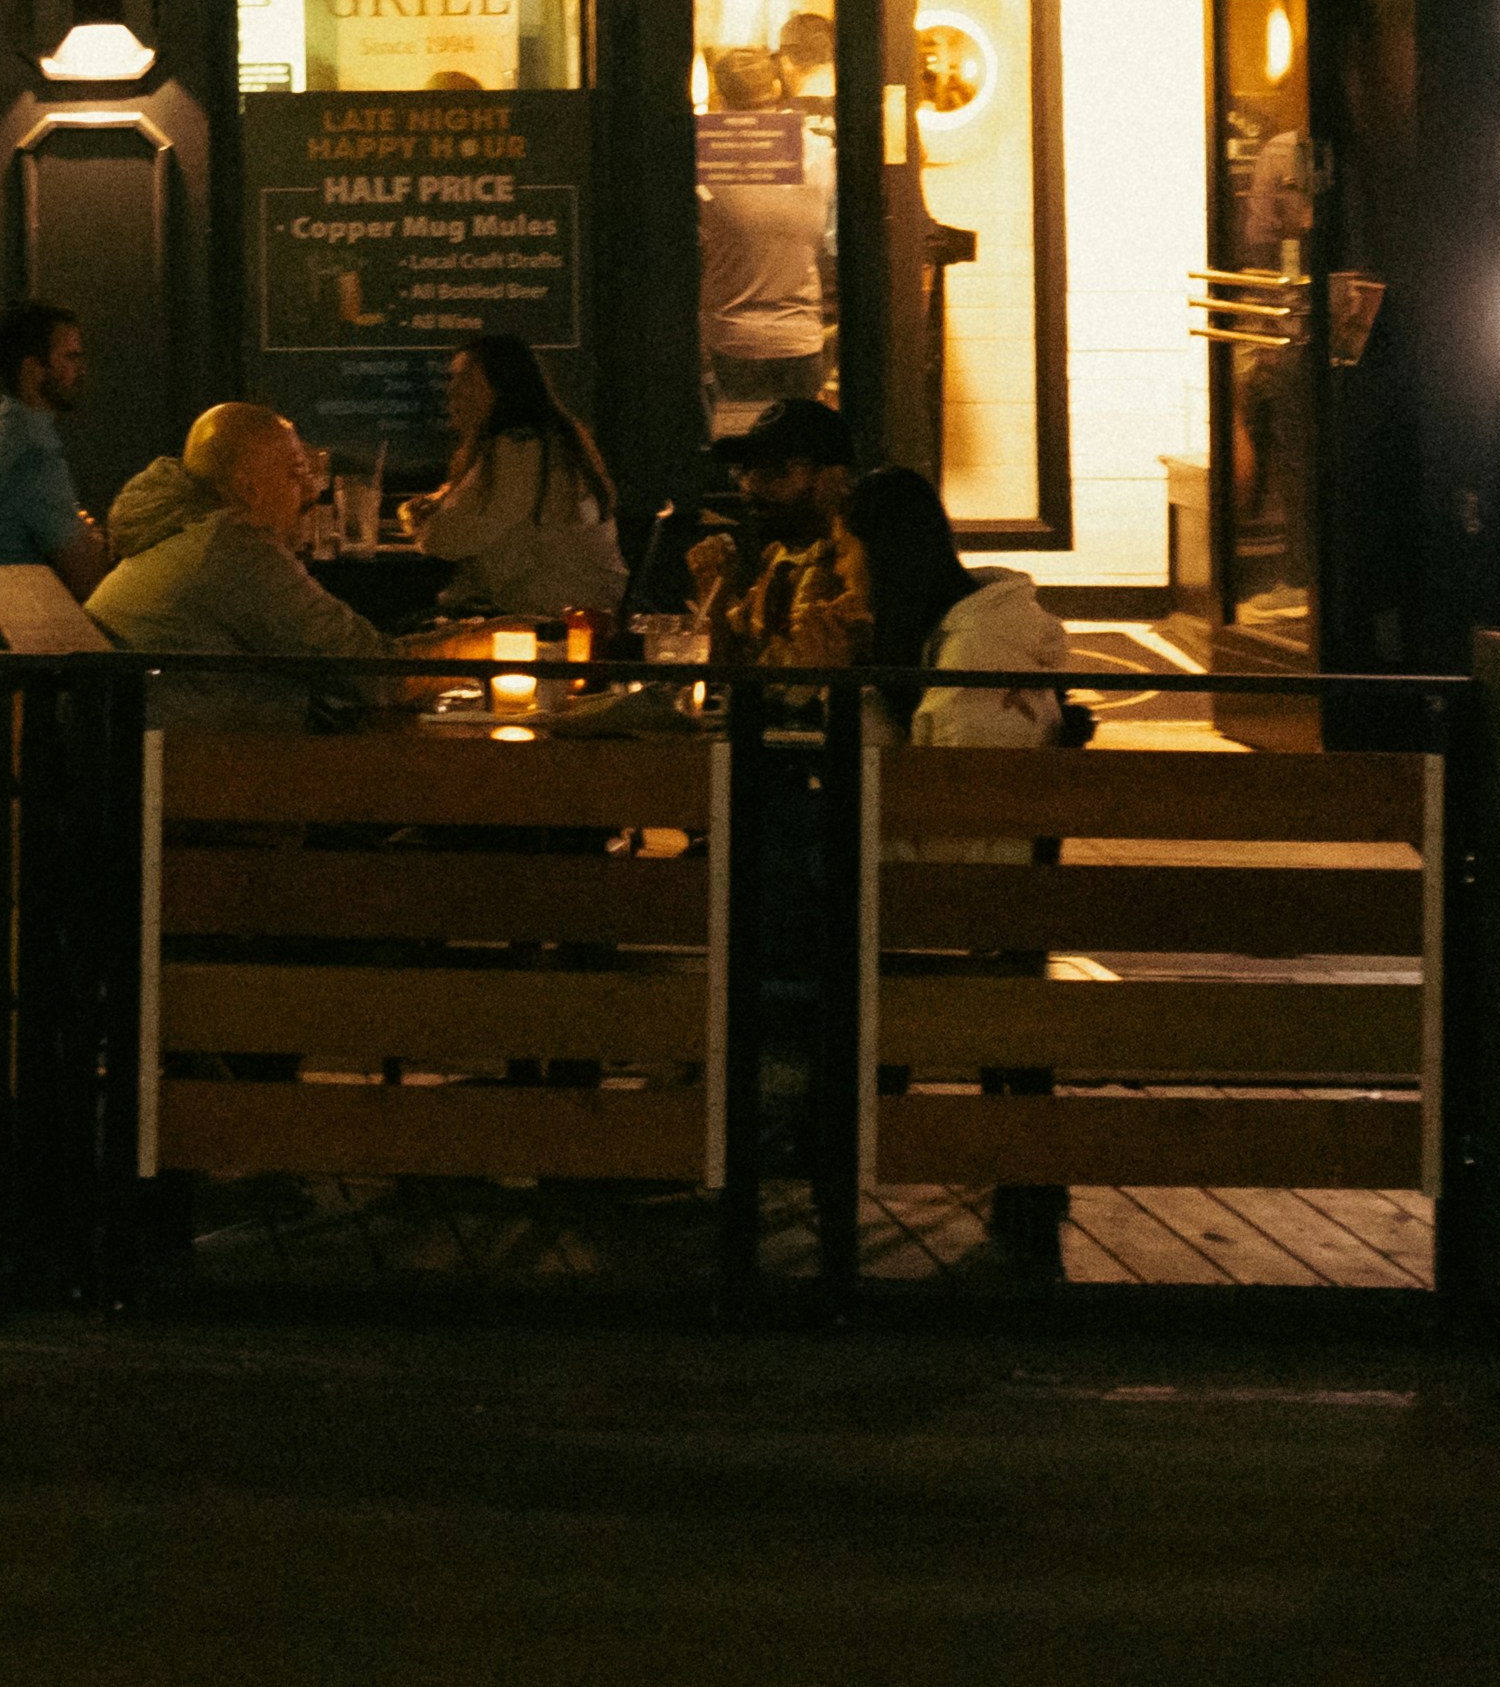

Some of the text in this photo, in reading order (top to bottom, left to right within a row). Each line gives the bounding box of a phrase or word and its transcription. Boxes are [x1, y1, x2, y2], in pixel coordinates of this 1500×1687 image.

[322, 107, 512, 133] LATE NIGHT
[307, 136, 415, 161] HAPPY
[323, 174, 516, 205] HALF PRICE
[289, 213, 557, 245] Copper Mug Mules
[409, 253, 457, 271] Local
